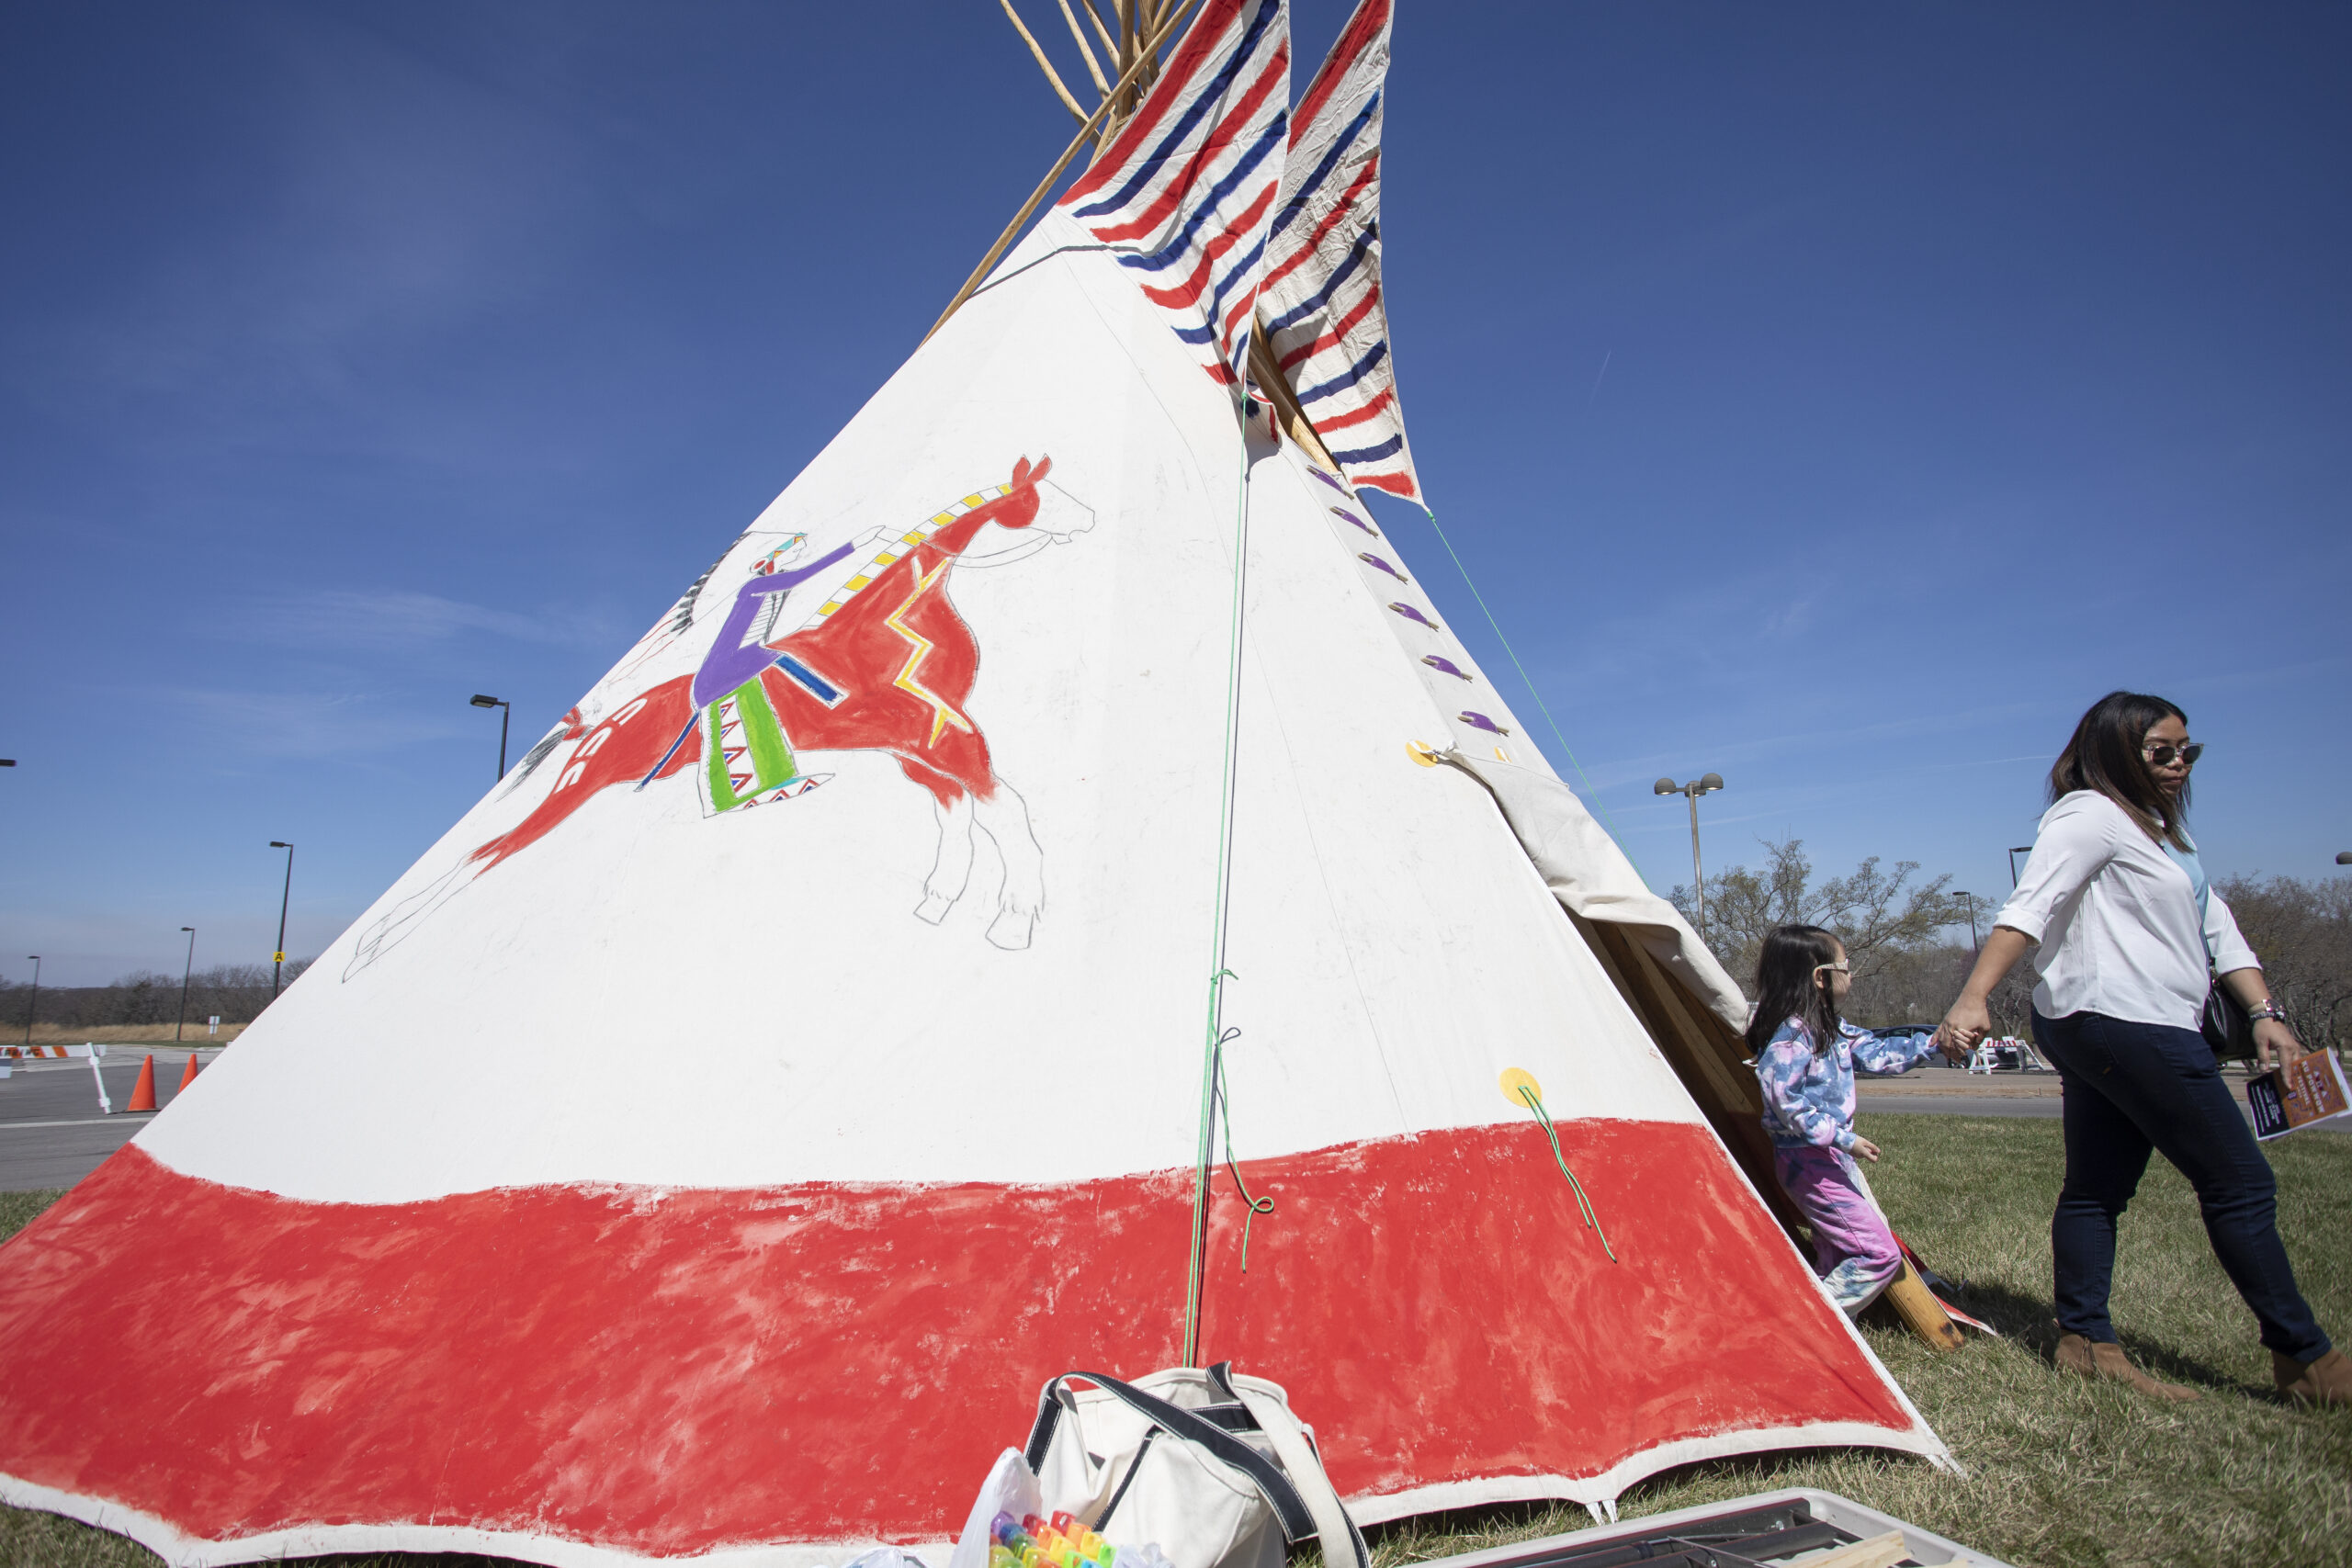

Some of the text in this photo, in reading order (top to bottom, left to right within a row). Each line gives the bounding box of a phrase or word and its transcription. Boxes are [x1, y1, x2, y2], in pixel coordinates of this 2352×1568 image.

[275, 953, 283, 961] A
[2301, 1060, 2310, 1073] KU
[2298, 1076, 2311, 1105] FESTIVAL
